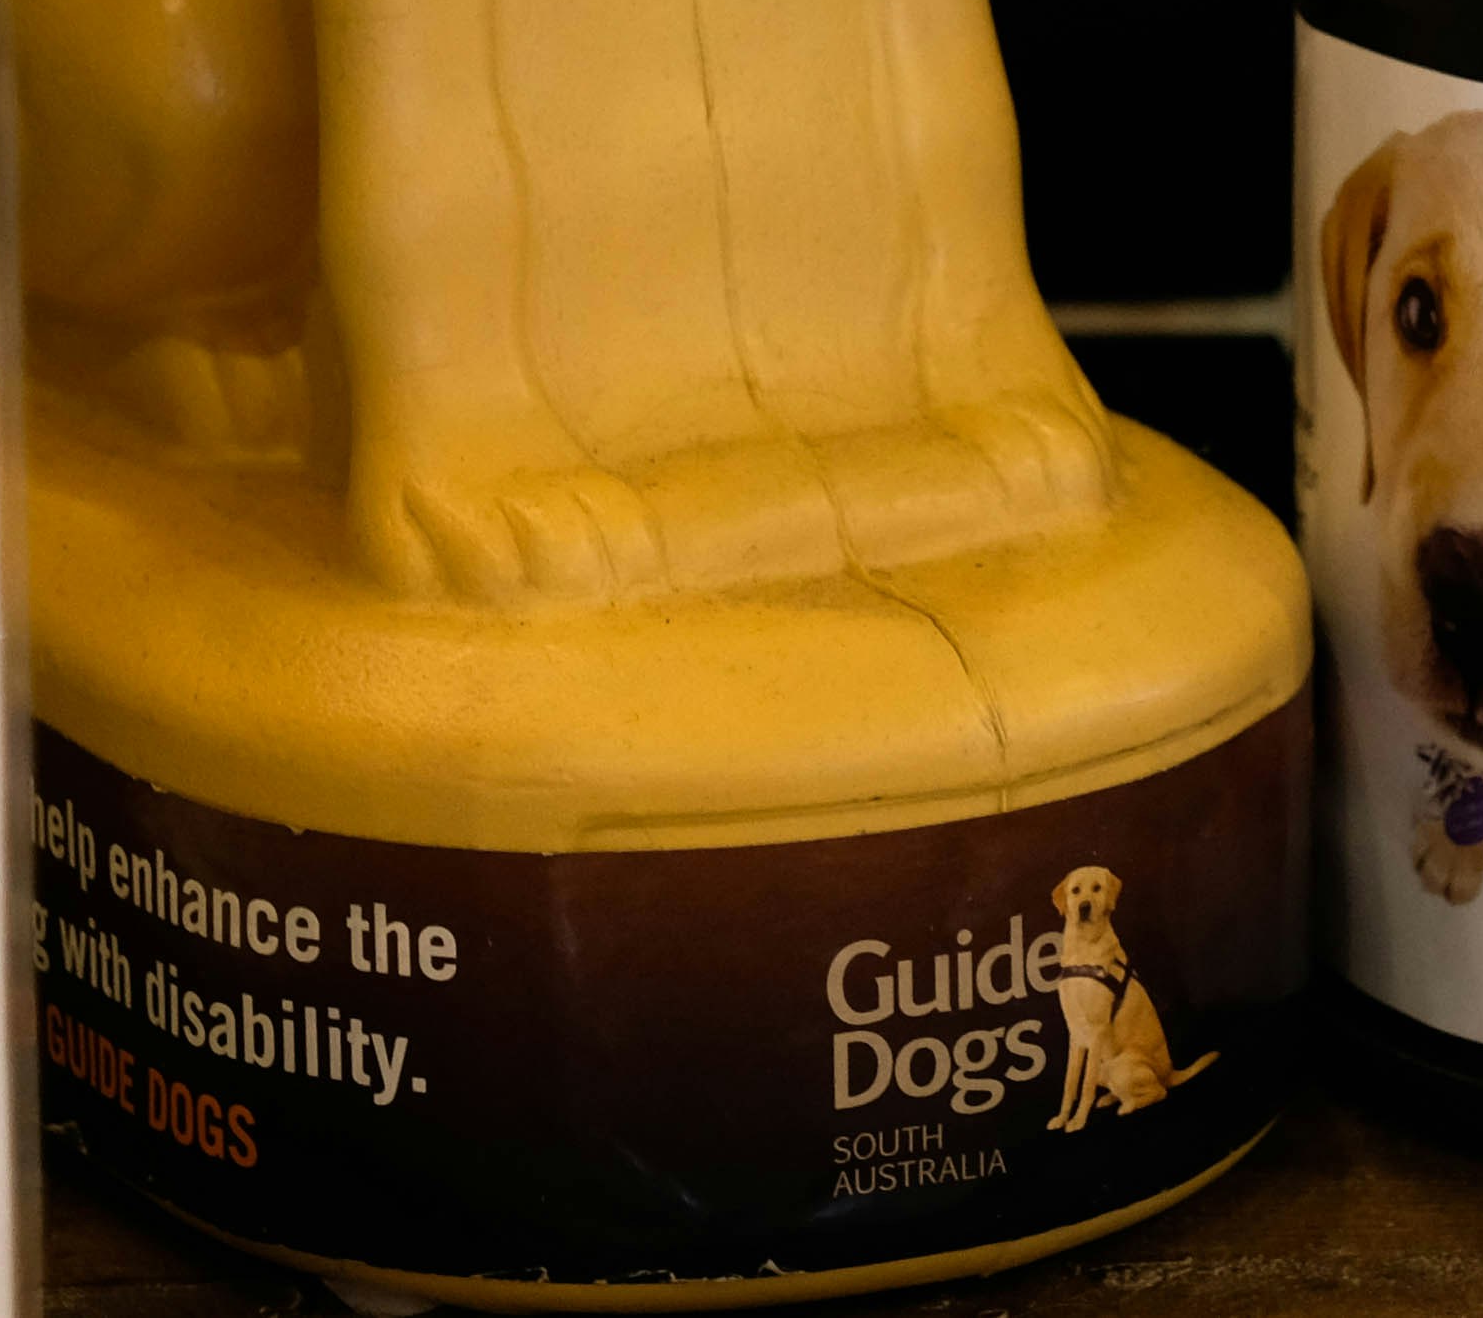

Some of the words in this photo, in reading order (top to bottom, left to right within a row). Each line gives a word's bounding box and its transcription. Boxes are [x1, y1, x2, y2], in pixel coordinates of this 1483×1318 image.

[108, 843, 321, 963] enhance
[346, 903, 458, 981] the
[59, 916, 132, 1010] with
[145, 961, 427, 1106] disability.
[826, 913, 1064, 1026] Guide
[46, 1003, 137, 1115] GUIDE
[148, 1066, 258, 1168] DOGS
[833, 1019, 1047, 1115] Dogs
[833, 1122, 944, 1165] SOUTH
[833, 1148, 1007, 1198] AUSTRALIA
